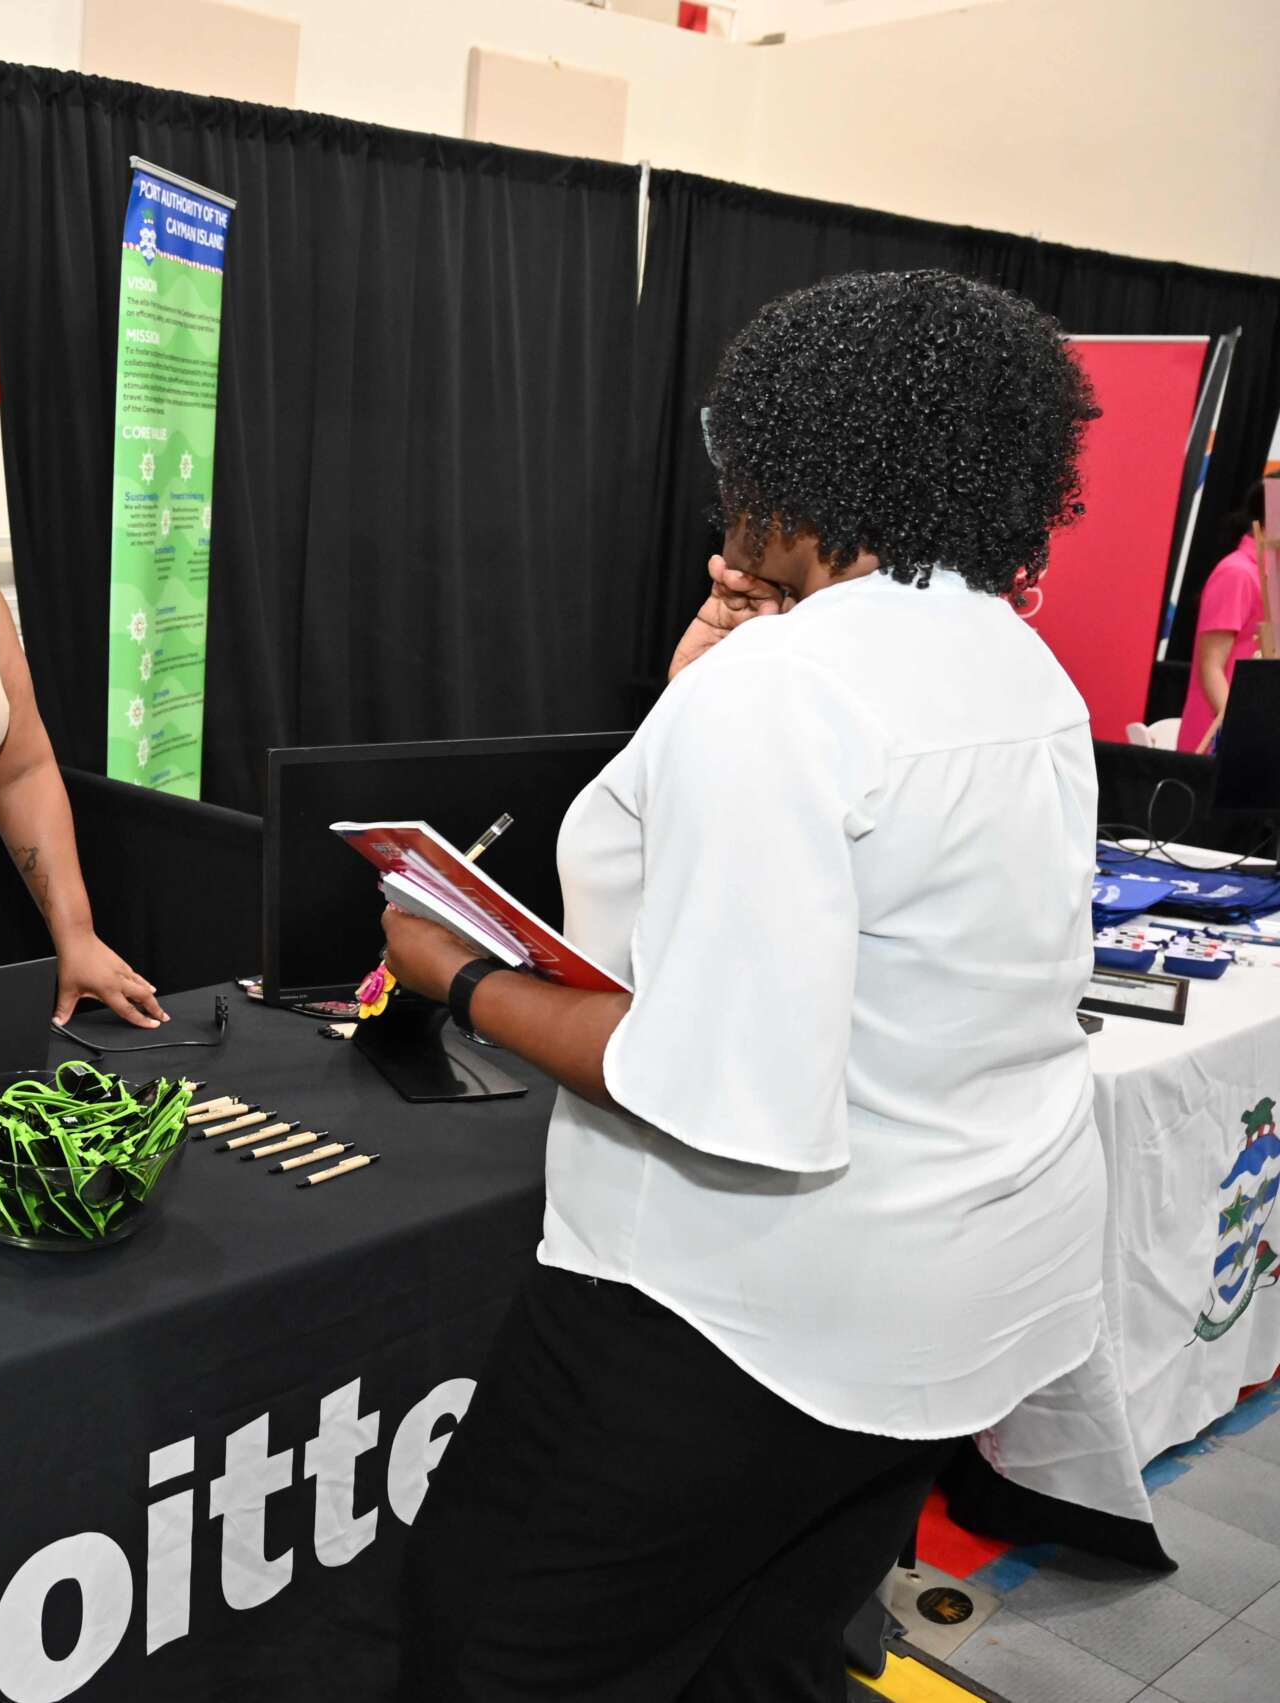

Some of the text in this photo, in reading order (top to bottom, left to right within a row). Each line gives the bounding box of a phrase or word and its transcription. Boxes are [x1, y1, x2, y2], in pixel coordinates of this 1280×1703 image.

[138, 180, 228, 229] PORT AUTHORITY OF THE
[165, 217, 197, 243] CAYMAN
